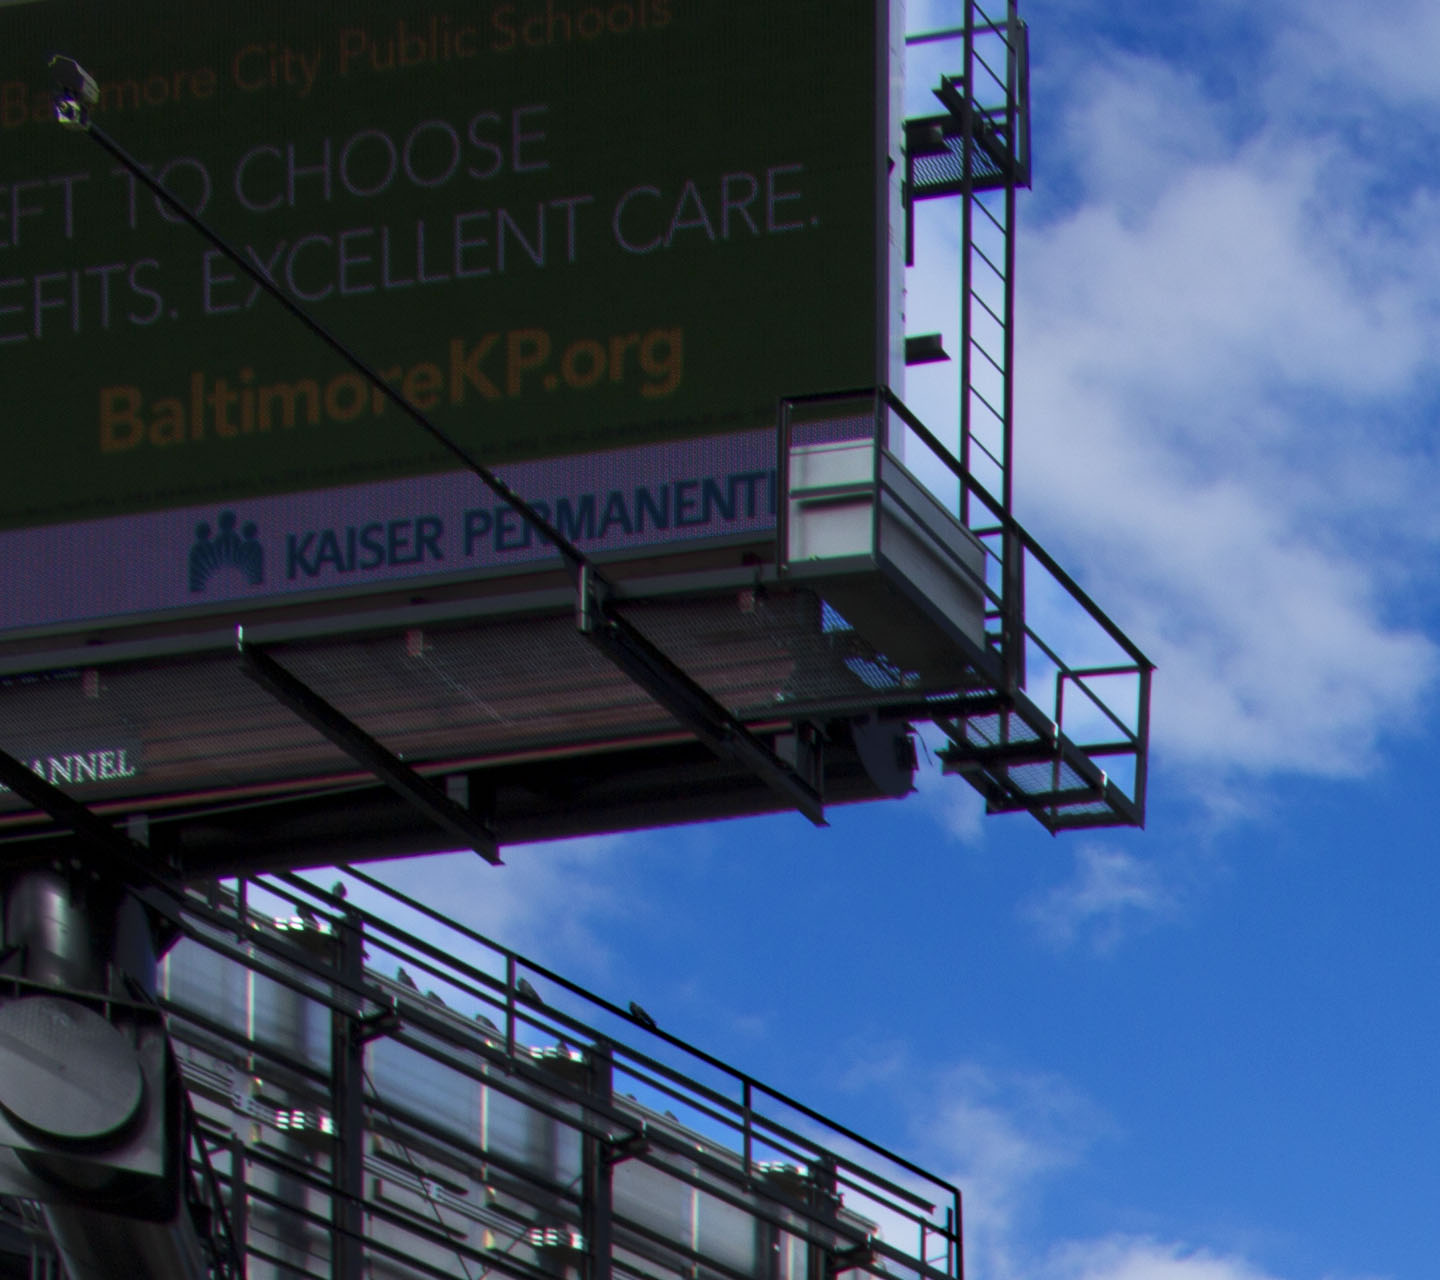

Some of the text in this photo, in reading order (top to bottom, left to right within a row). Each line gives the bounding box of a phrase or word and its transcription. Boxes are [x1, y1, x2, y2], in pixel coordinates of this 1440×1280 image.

[2, 0, 672, 129] Bamore City Public Schools
[112, 156, 212, 229] TO
[234, 105, 550, 211] CHOOSE
[204, 194, 594, 314] EXCELLENT
[612, 163, 818, 254] CARE.
[100, 327, 683, 454] BaltimoreKP.org
[287, 515, 444, 580] KAISER
